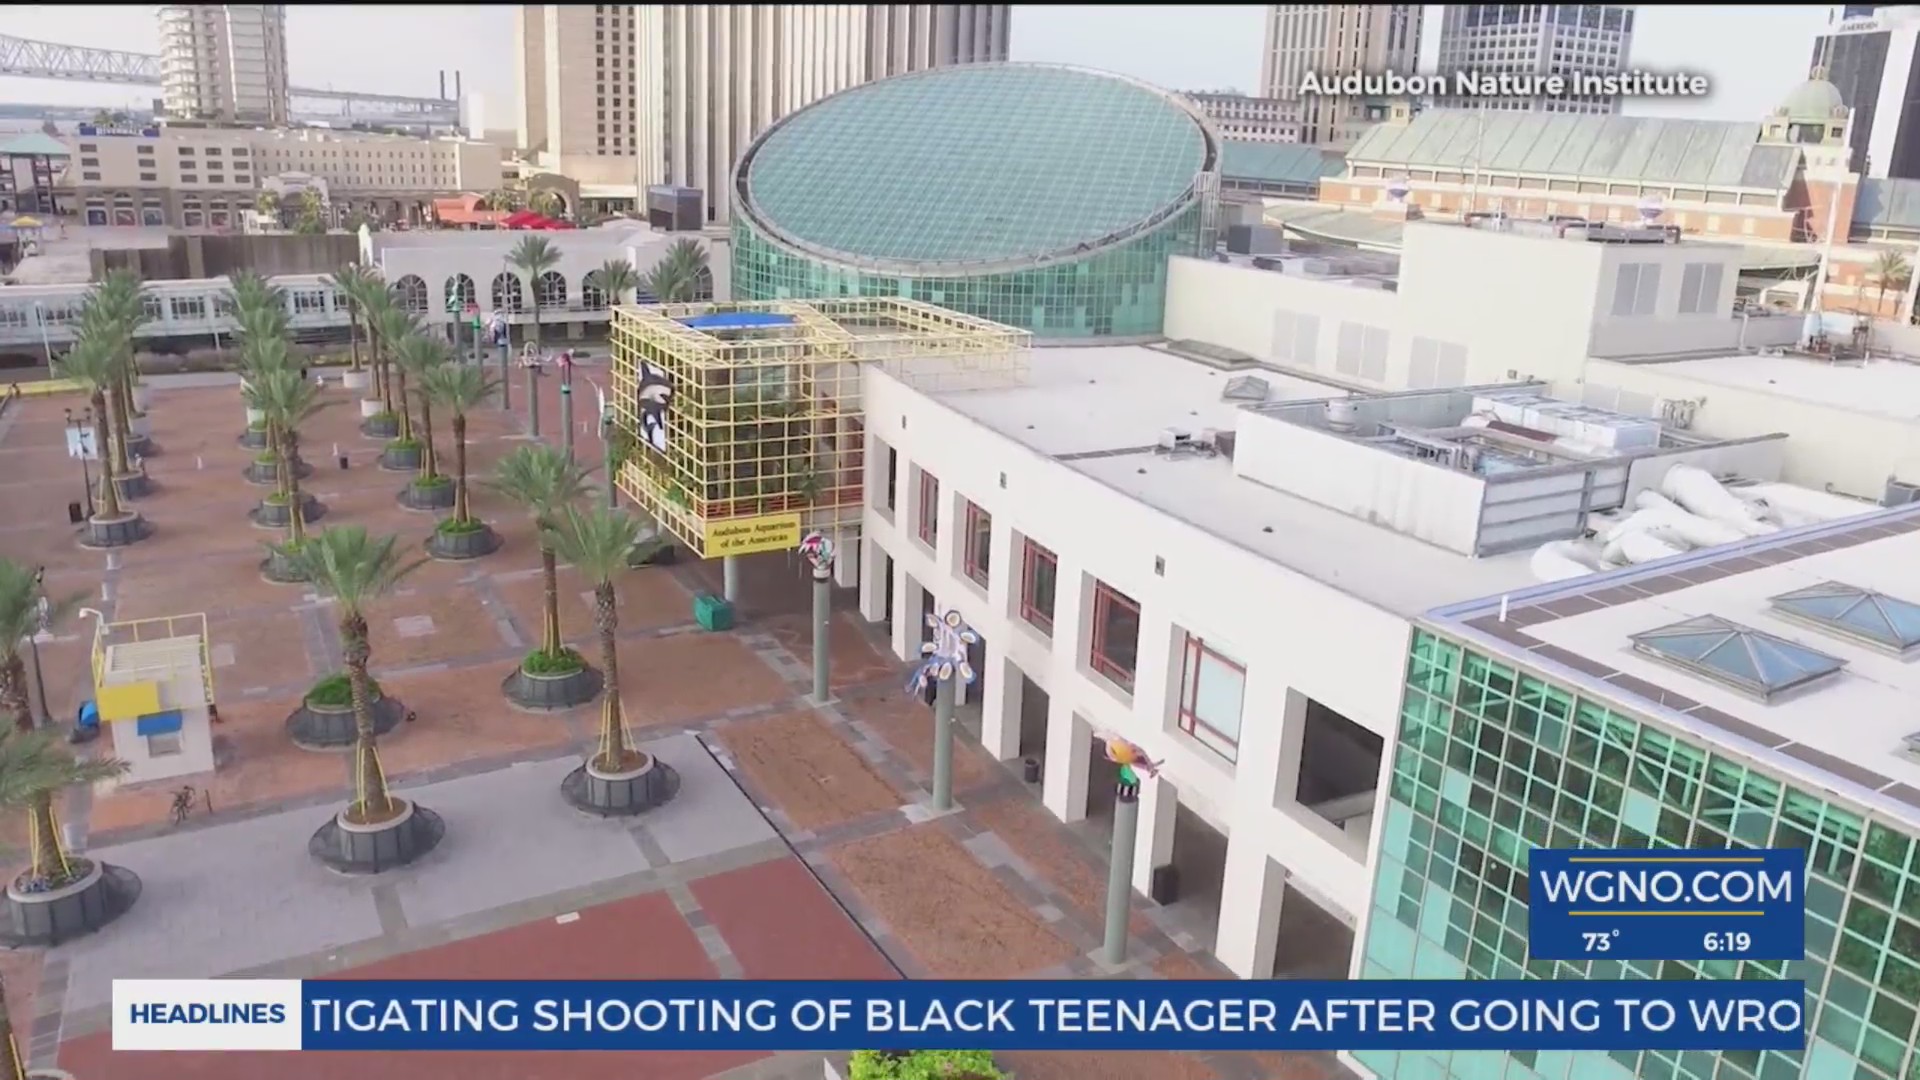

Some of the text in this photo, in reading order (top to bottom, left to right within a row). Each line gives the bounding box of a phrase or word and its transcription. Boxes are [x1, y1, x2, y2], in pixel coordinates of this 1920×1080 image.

[711, 521, 797, 538] Audubon Aquarium
[720, 534, 789, 548] of the Americas
